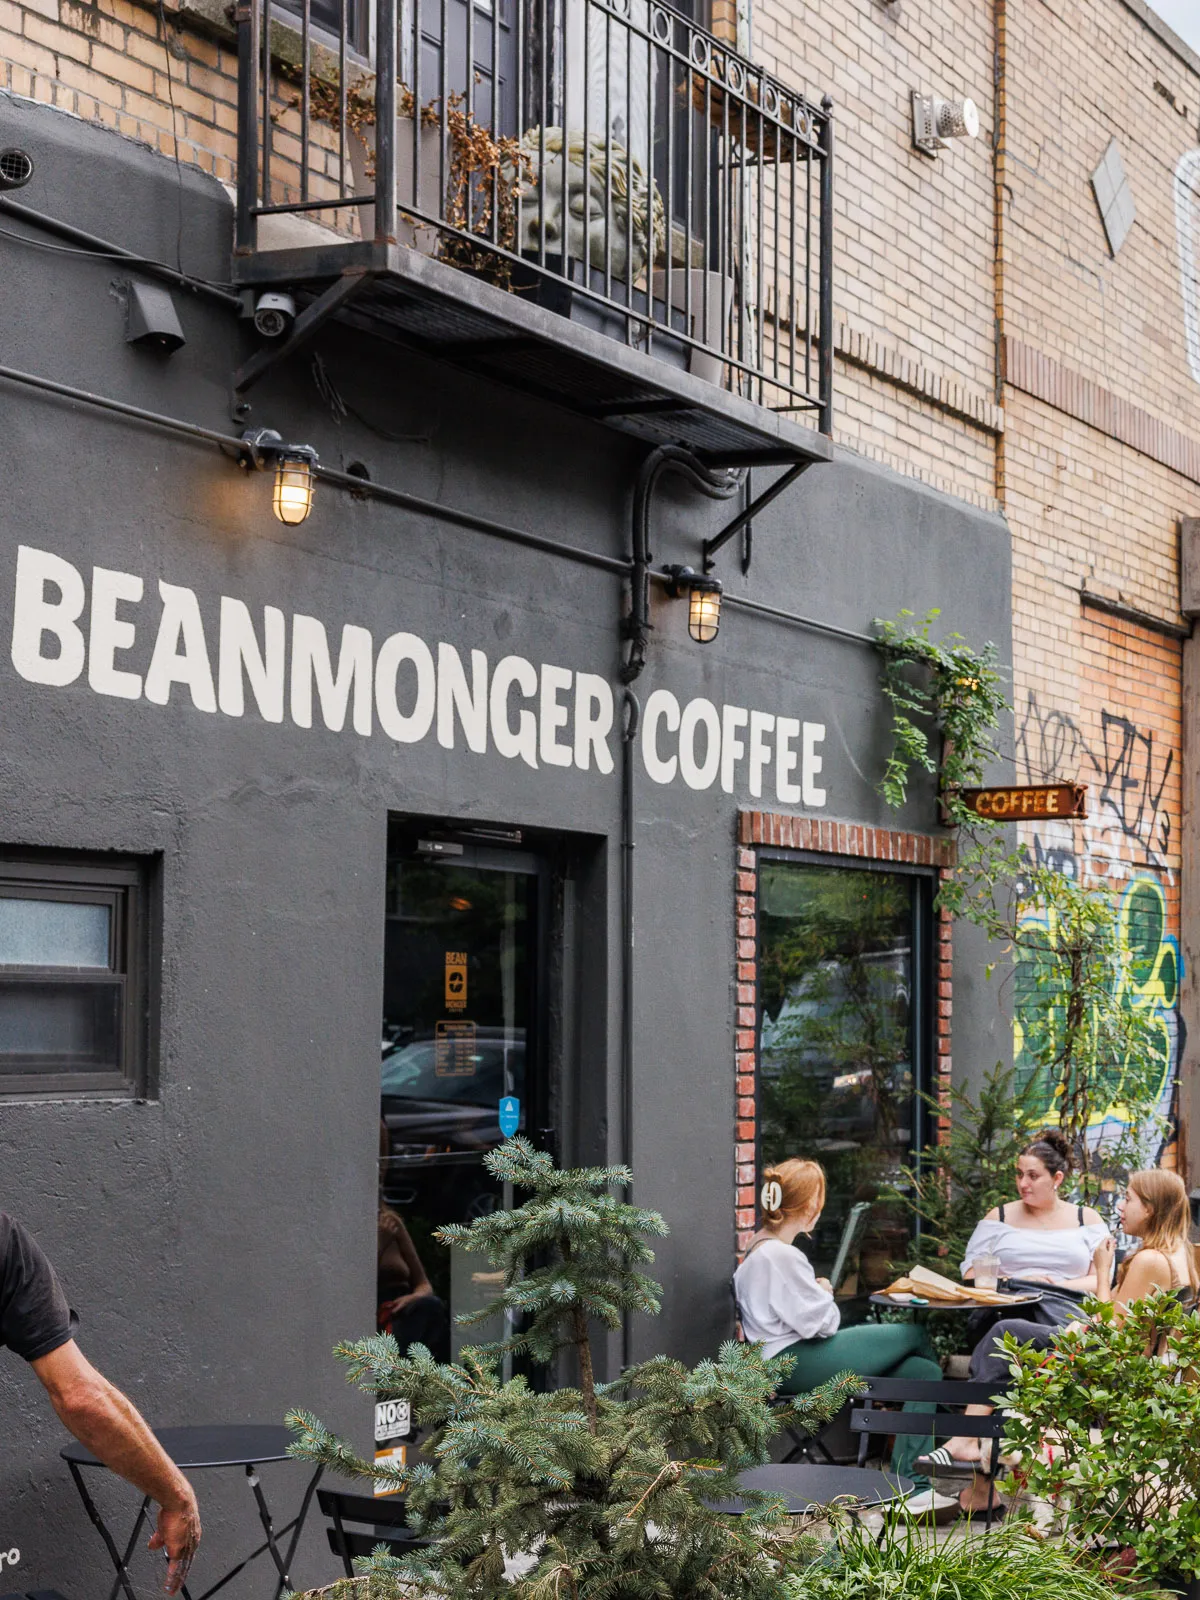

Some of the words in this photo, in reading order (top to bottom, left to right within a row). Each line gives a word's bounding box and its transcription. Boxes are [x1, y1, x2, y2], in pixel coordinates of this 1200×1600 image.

[11, 545, 614, 775] BEANMONGER
[642, 690, 828, 807] COFFEE
[975, 790, 1059, 815] COFFEE
[445, 952, 467, 965] BEAN
[377, 1403, 396, 1426] NO
